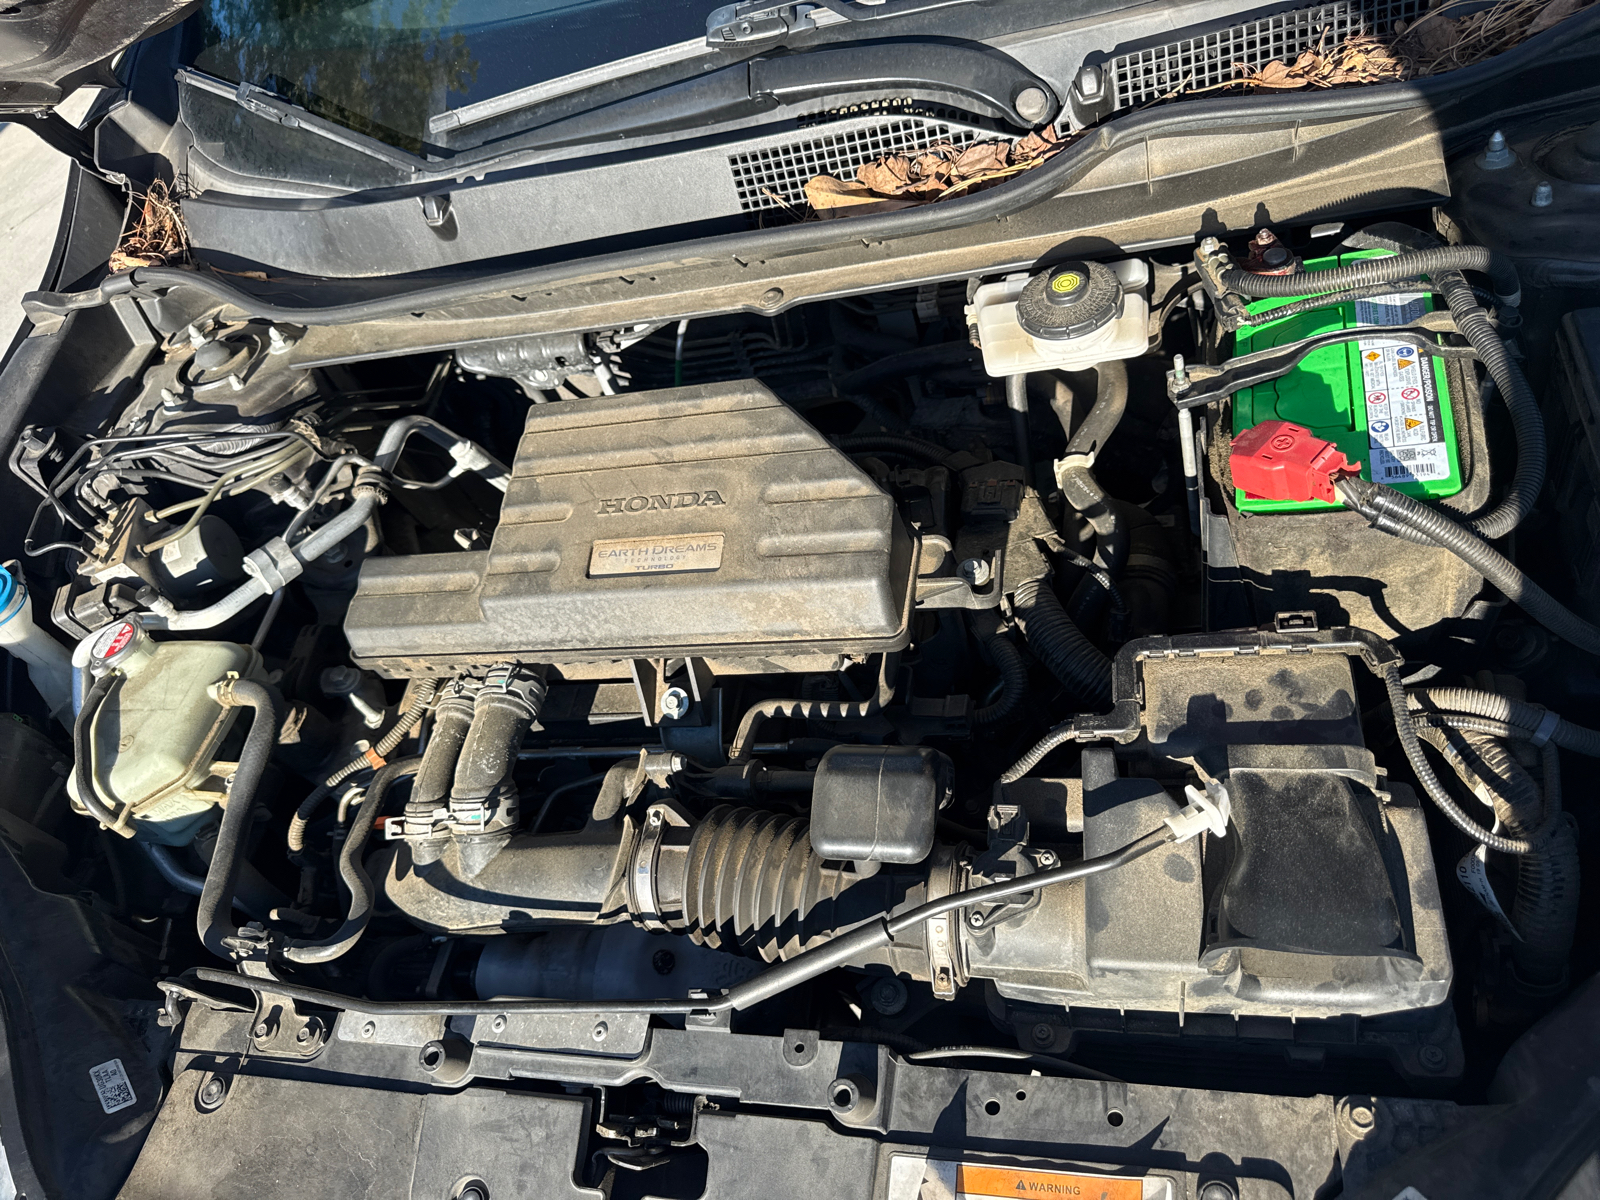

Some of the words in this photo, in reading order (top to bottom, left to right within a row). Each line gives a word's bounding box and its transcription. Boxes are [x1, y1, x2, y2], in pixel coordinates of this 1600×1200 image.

[1420, 357, 1434, 402] DANGER/POISON
[597, 490, 726, 514] HONDA
[598, 547, 649, 558] EARTH
[652, 543, 717, 555] DREAMS
[624, 555, 687, 564] TECHNOLOGY
[1029, 1181, 1081, 1195] WARNING
